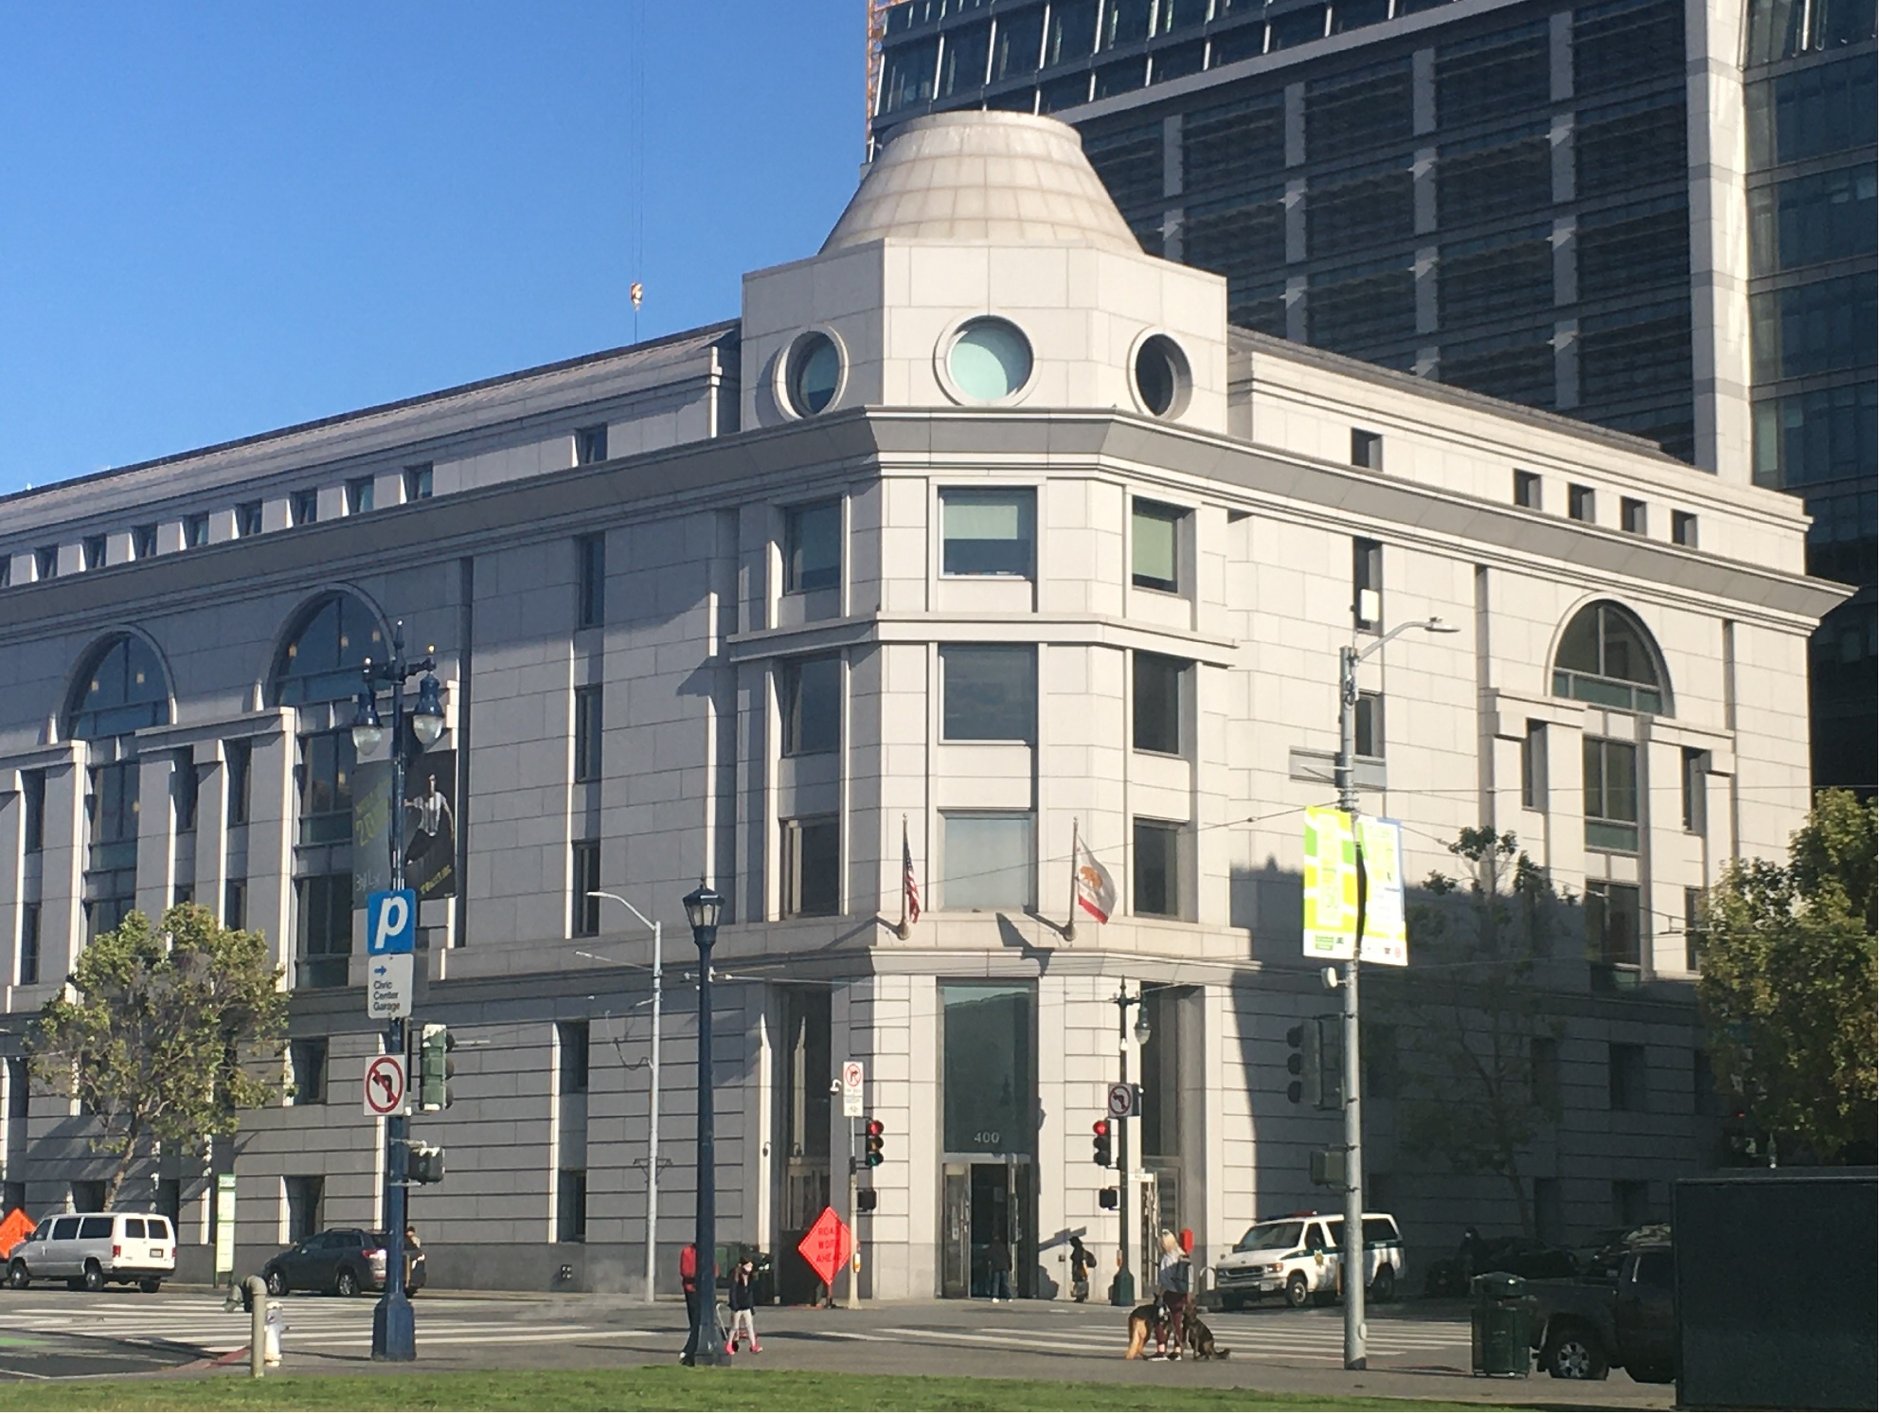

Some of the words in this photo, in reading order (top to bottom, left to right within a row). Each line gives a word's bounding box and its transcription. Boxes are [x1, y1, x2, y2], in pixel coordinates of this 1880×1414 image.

[373, 981, 392, 989] Civic
[373, 991, 398, 1000] Center
[373, 1002, 400, 1012] Garage
[974, 1132, 1000, 1143] 400
